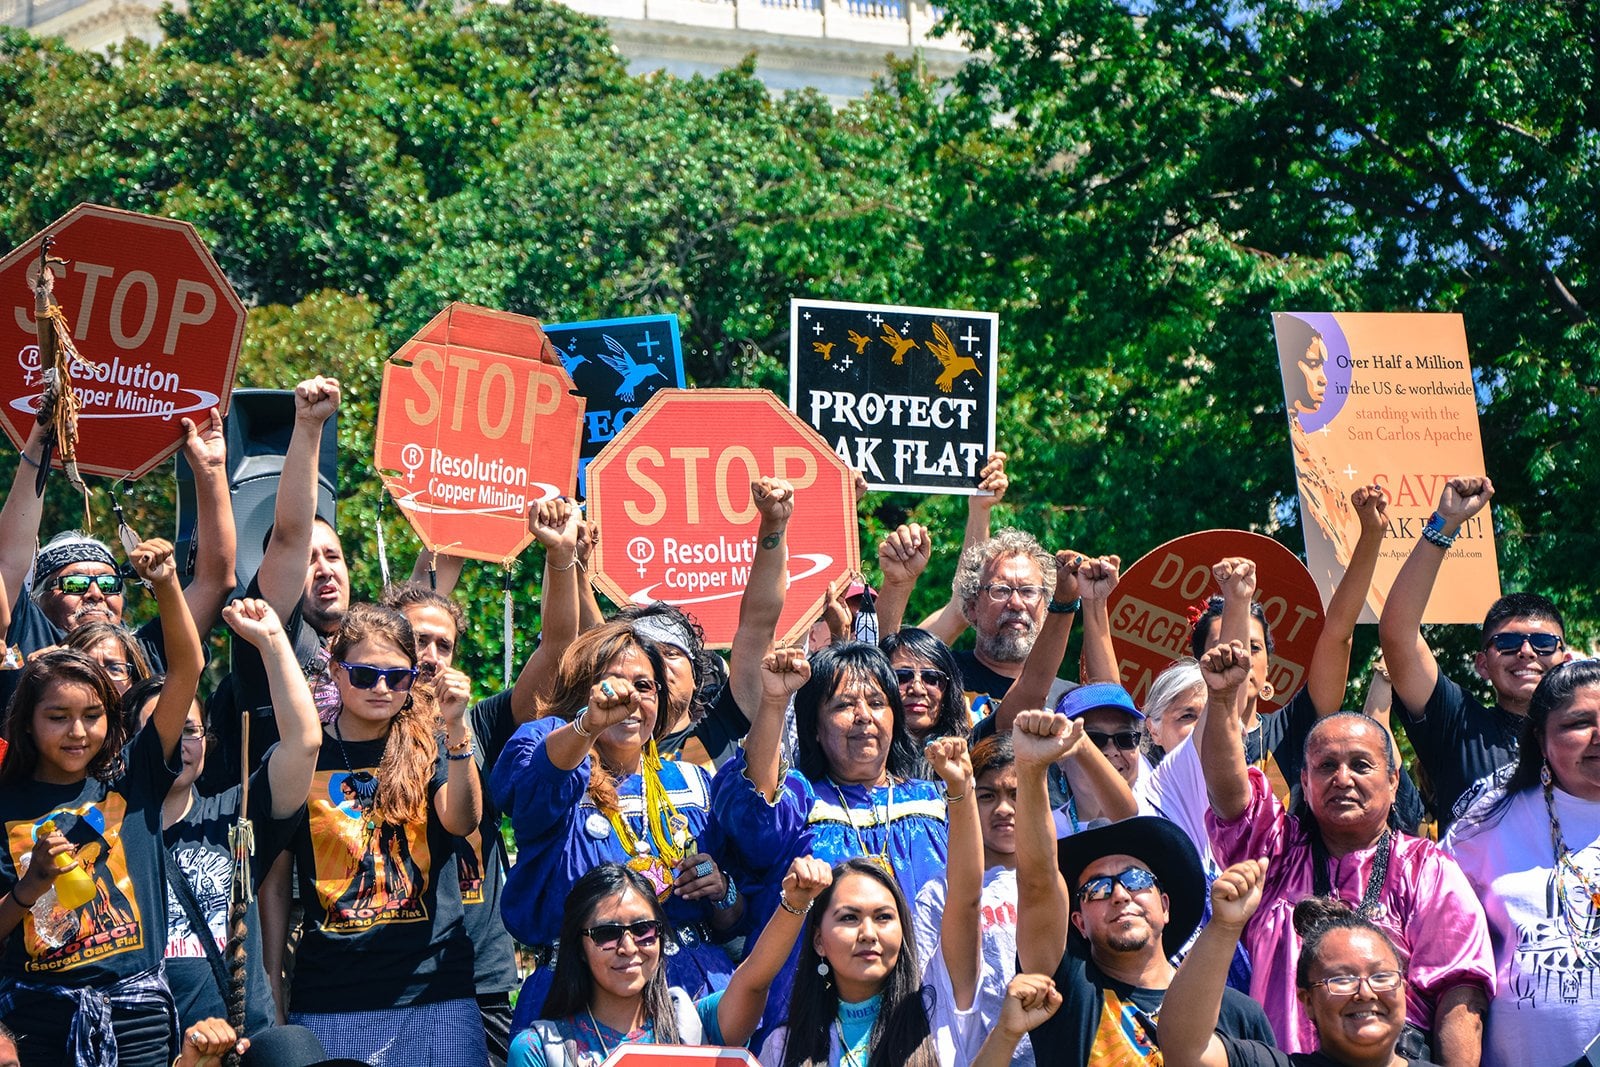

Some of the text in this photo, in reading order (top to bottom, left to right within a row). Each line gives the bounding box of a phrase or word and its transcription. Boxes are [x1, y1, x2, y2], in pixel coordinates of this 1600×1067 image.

[14, 254, 217, 355] STOP
[1336, 354, 1464, 370] Over Half a Million
[116, 389, 175, 421] Mining
[404, 348, 562, 444] STOP
[1335, 381, 1473, 396] in the US & worldwide
[808, 390, 977, 431] PROTECT
[1356, 406, 1460, 424] standing with the
[1348, 425, 1473, 446] San Carlos Apache
[429, 448, 527, 487] Resolution
[821, 435, 984, 484] AK FLAT
[428, 477, 525, 514] Copper Mining
[624, 445, 818, 526] STOP
[1372, 473, 1460, 508] SAV
[1383, 517, 1416, 539] AK
[665, 567, 727, 592] Copper
[1150, 552, 1318, 643] DO OT
[1112, 602, 1193, 654] SACR
[401, 909, 422, 918] Flat
[30, 935, 138, 972] Sacred Oak Flat
